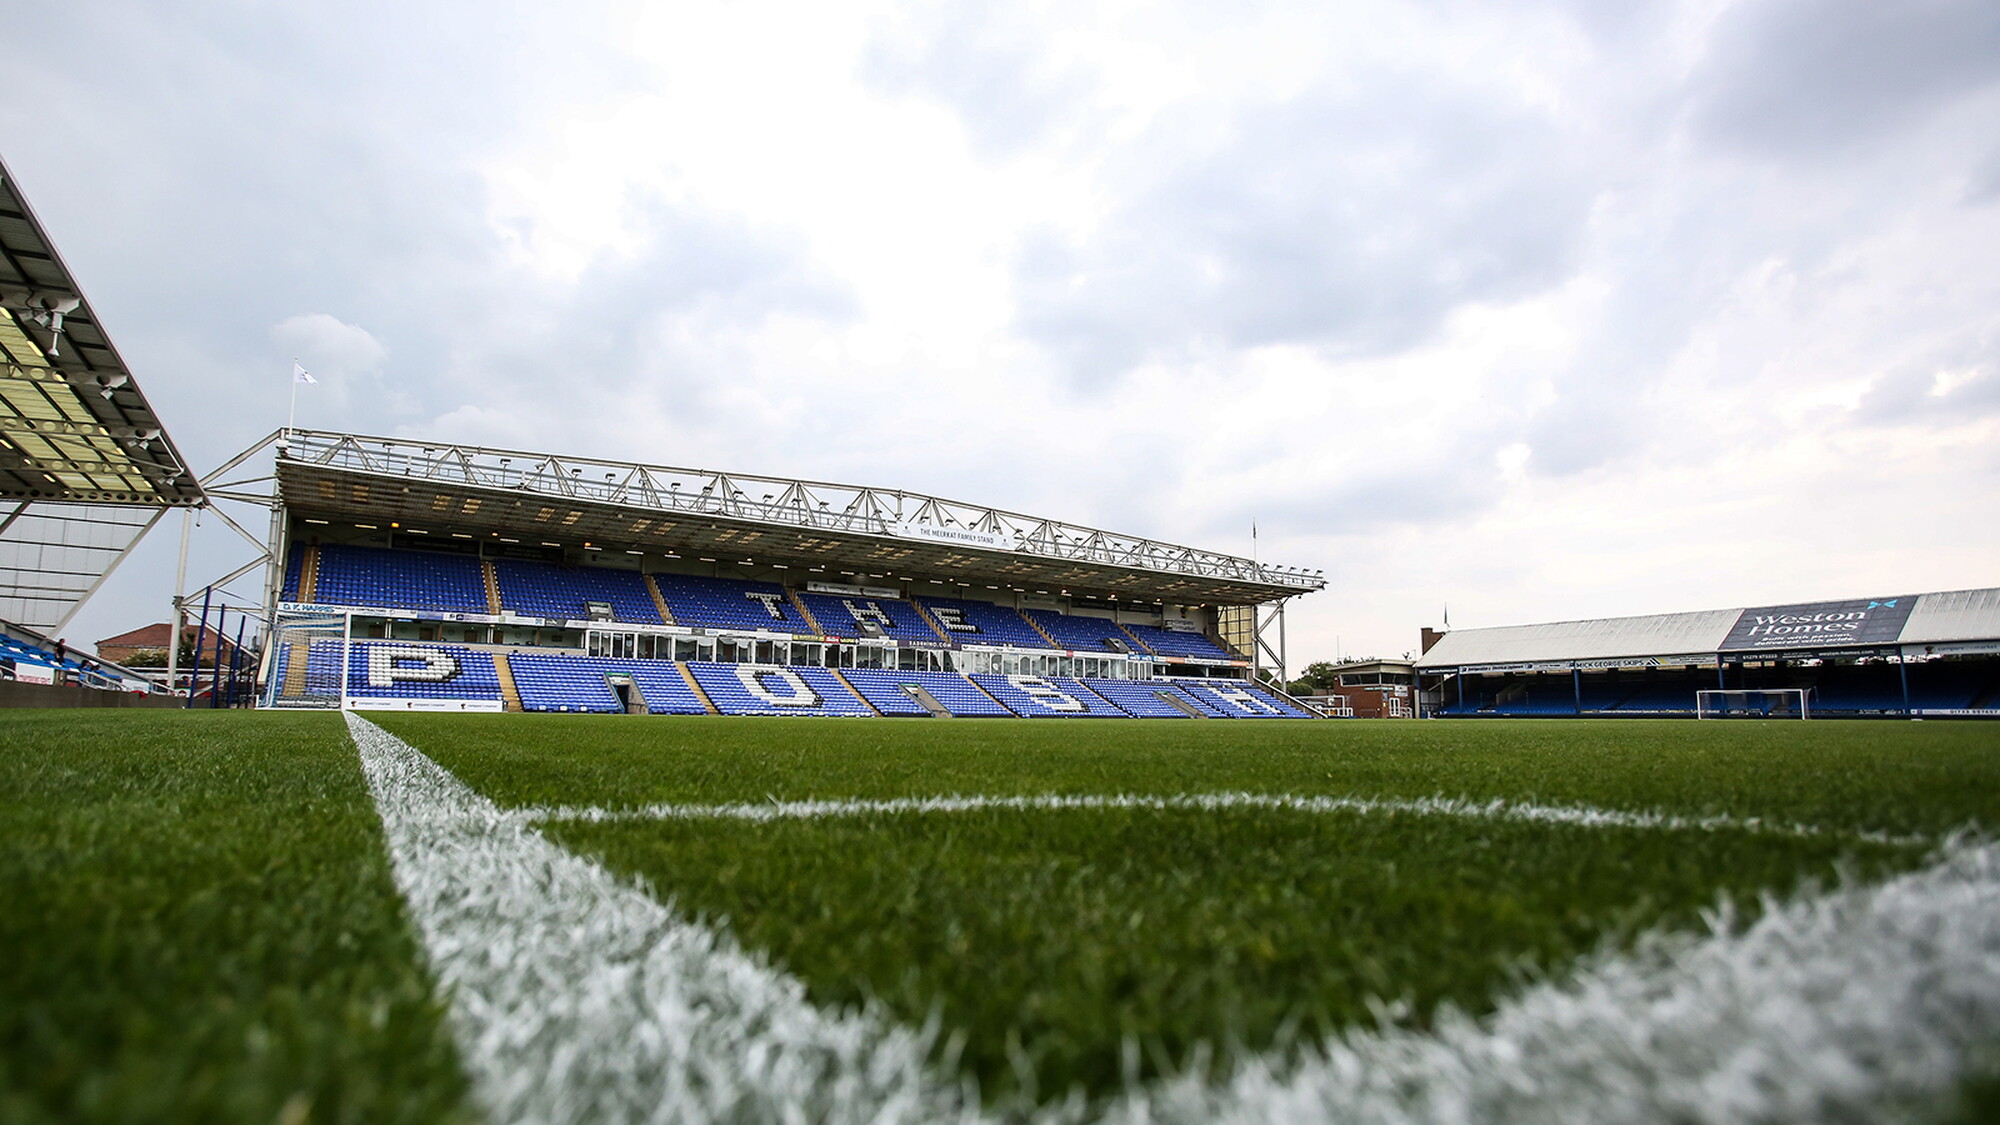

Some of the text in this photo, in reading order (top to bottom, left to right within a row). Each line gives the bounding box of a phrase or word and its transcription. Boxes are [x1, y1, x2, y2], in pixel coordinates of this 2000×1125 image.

[920, 528, 994, 544] THE MEERKAT FAMILY STAND
[1754, 611, 1866, 626] Weston
[1748, 621, 1859, 636] Homes
